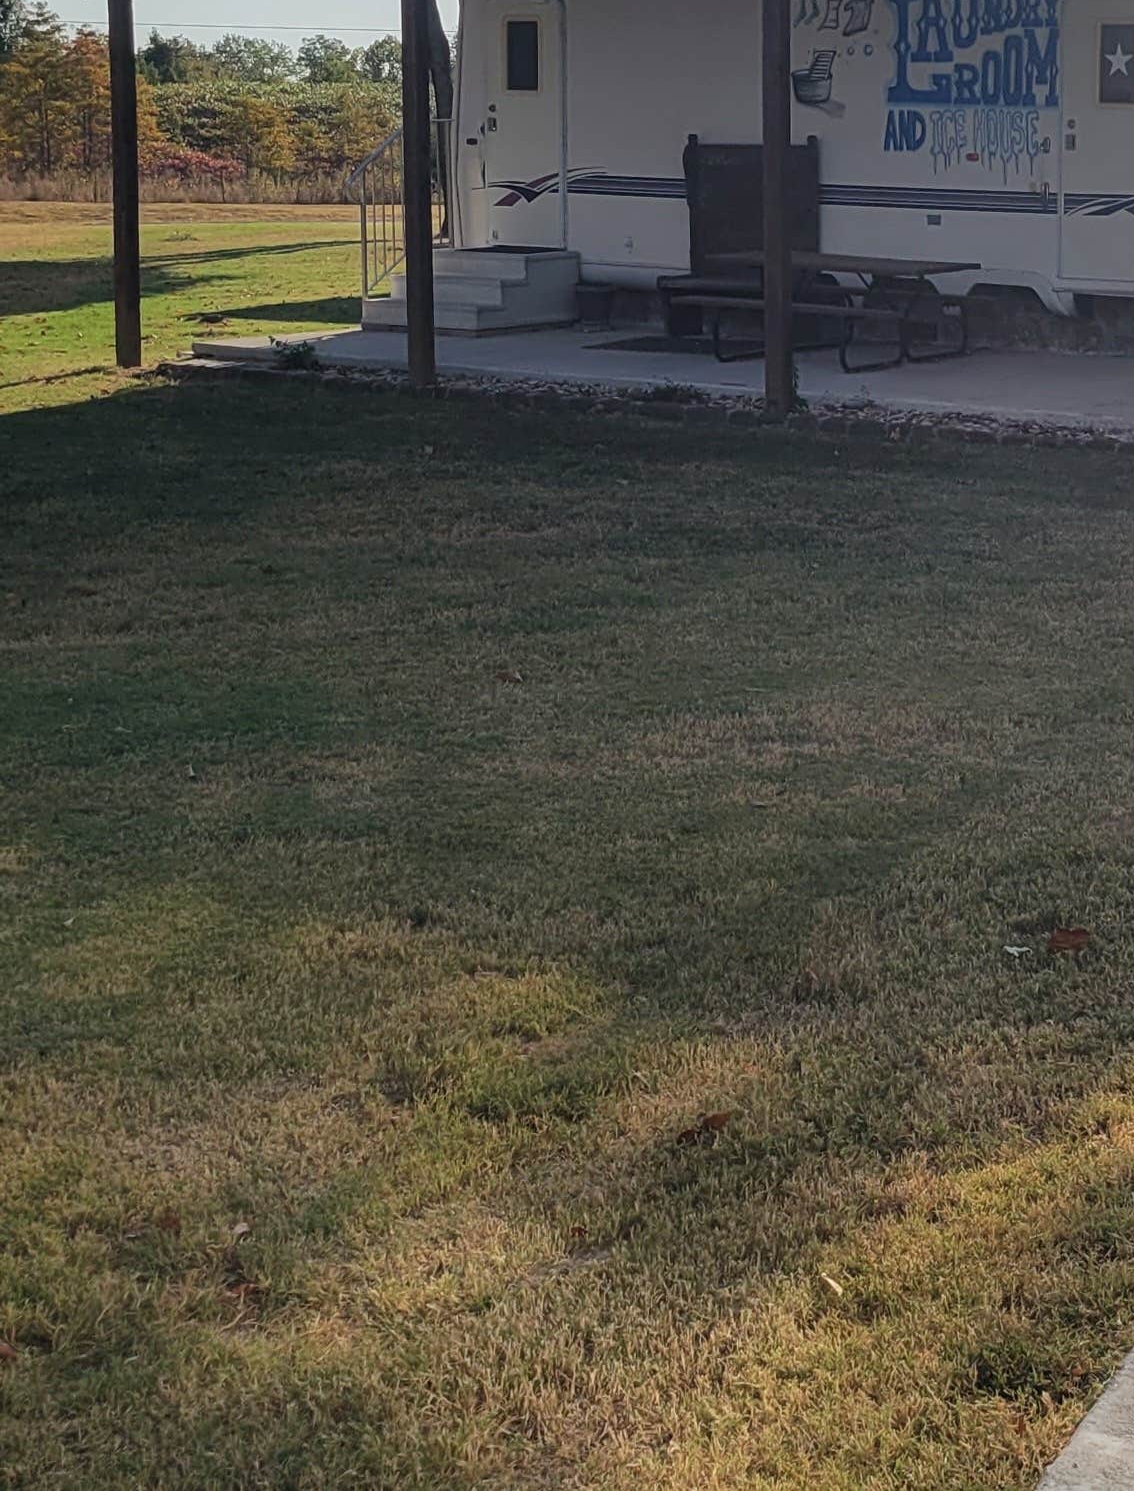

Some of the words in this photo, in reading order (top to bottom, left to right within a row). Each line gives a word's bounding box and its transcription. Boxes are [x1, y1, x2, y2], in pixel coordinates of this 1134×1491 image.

[953, 28, 1060, 106] ROOM
[884, 109, 926, 152] AND
[929, 109, 968, 165] ICE
[972, 108, 1040, 169] HOUSE
